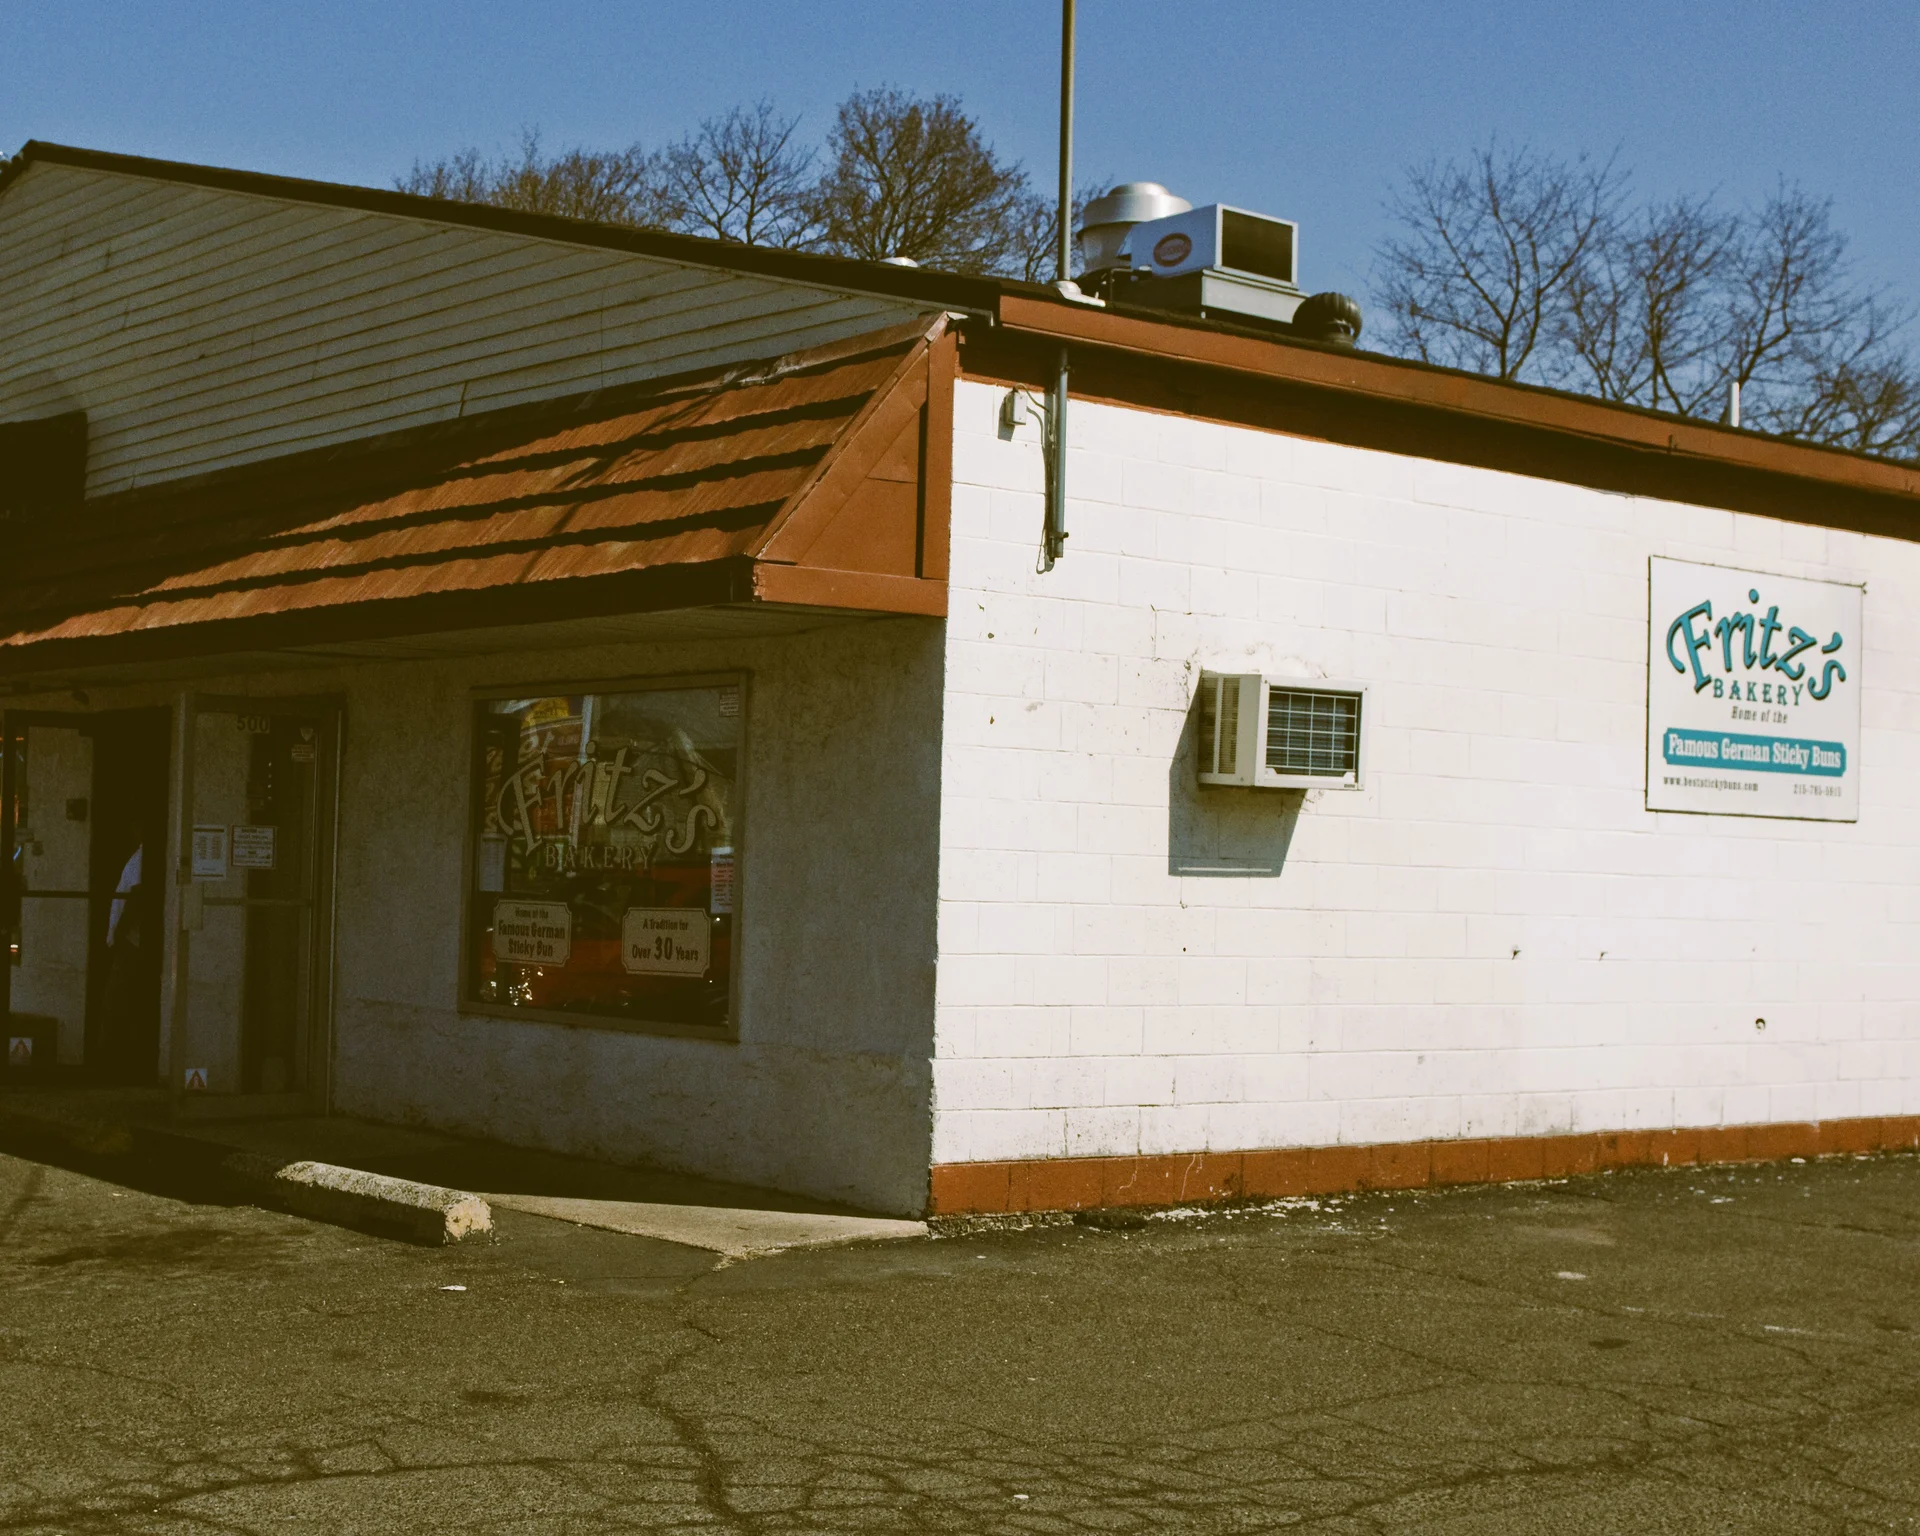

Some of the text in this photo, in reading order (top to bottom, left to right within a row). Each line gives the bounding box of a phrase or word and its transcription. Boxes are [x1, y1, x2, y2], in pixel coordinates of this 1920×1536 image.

[1666, 588, 1847, 701] Fritz's
[1713, 678, 1805, 707] BAKERY
[237, 716, 269, 732] 500
[1731, 706, 1788, 724] Home of the
[1668, 733, 1842, 769] Famous German Sticky Buns
[496, 740, 718, 857] Fritz's
[544, 843, 656, 870] BAKERY
[539, 908, 549, 918] the
[498, 920, 565, 939] Famous German
[642, 918, 689, 931] A Tradition for
[508, 939, 554, 957] Sticky Bun
[632, 936, 699, 962] Over 30 Years
